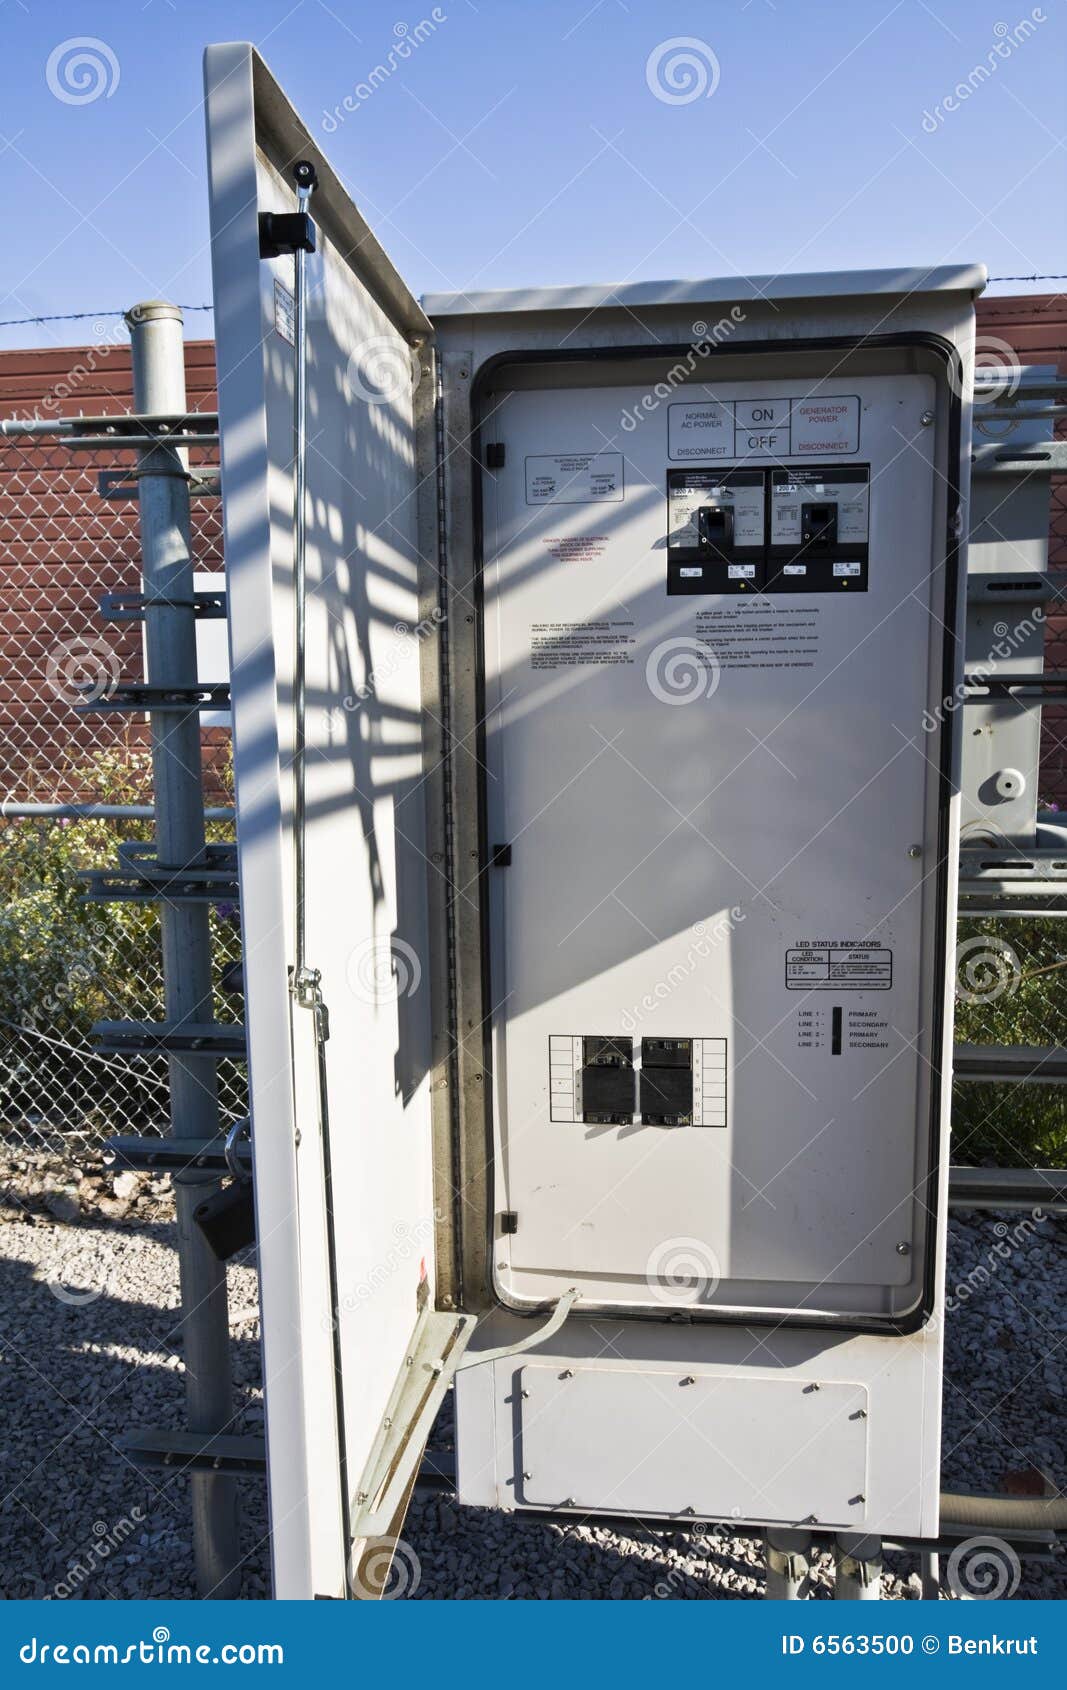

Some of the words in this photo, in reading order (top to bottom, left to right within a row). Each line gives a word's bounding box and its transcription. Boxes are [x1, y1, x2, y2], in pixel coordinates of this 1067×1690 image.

[800, 406, 848, 415] GENERATOR
[685, 412, 718, 421] NORMAL
[751, 409, 774, 422] ON
[808, 415, 838, 423] POWER
[681, 421, 693, 429] AC
[695, 420, 722, 428] POWER
[747, 435, 777, 449] OFF
[799, 441, 848, 450] DISCONNECT
[677, 447, 726, 456] DISCONNECT
[840, 940, 882, 948] INDICATORS
